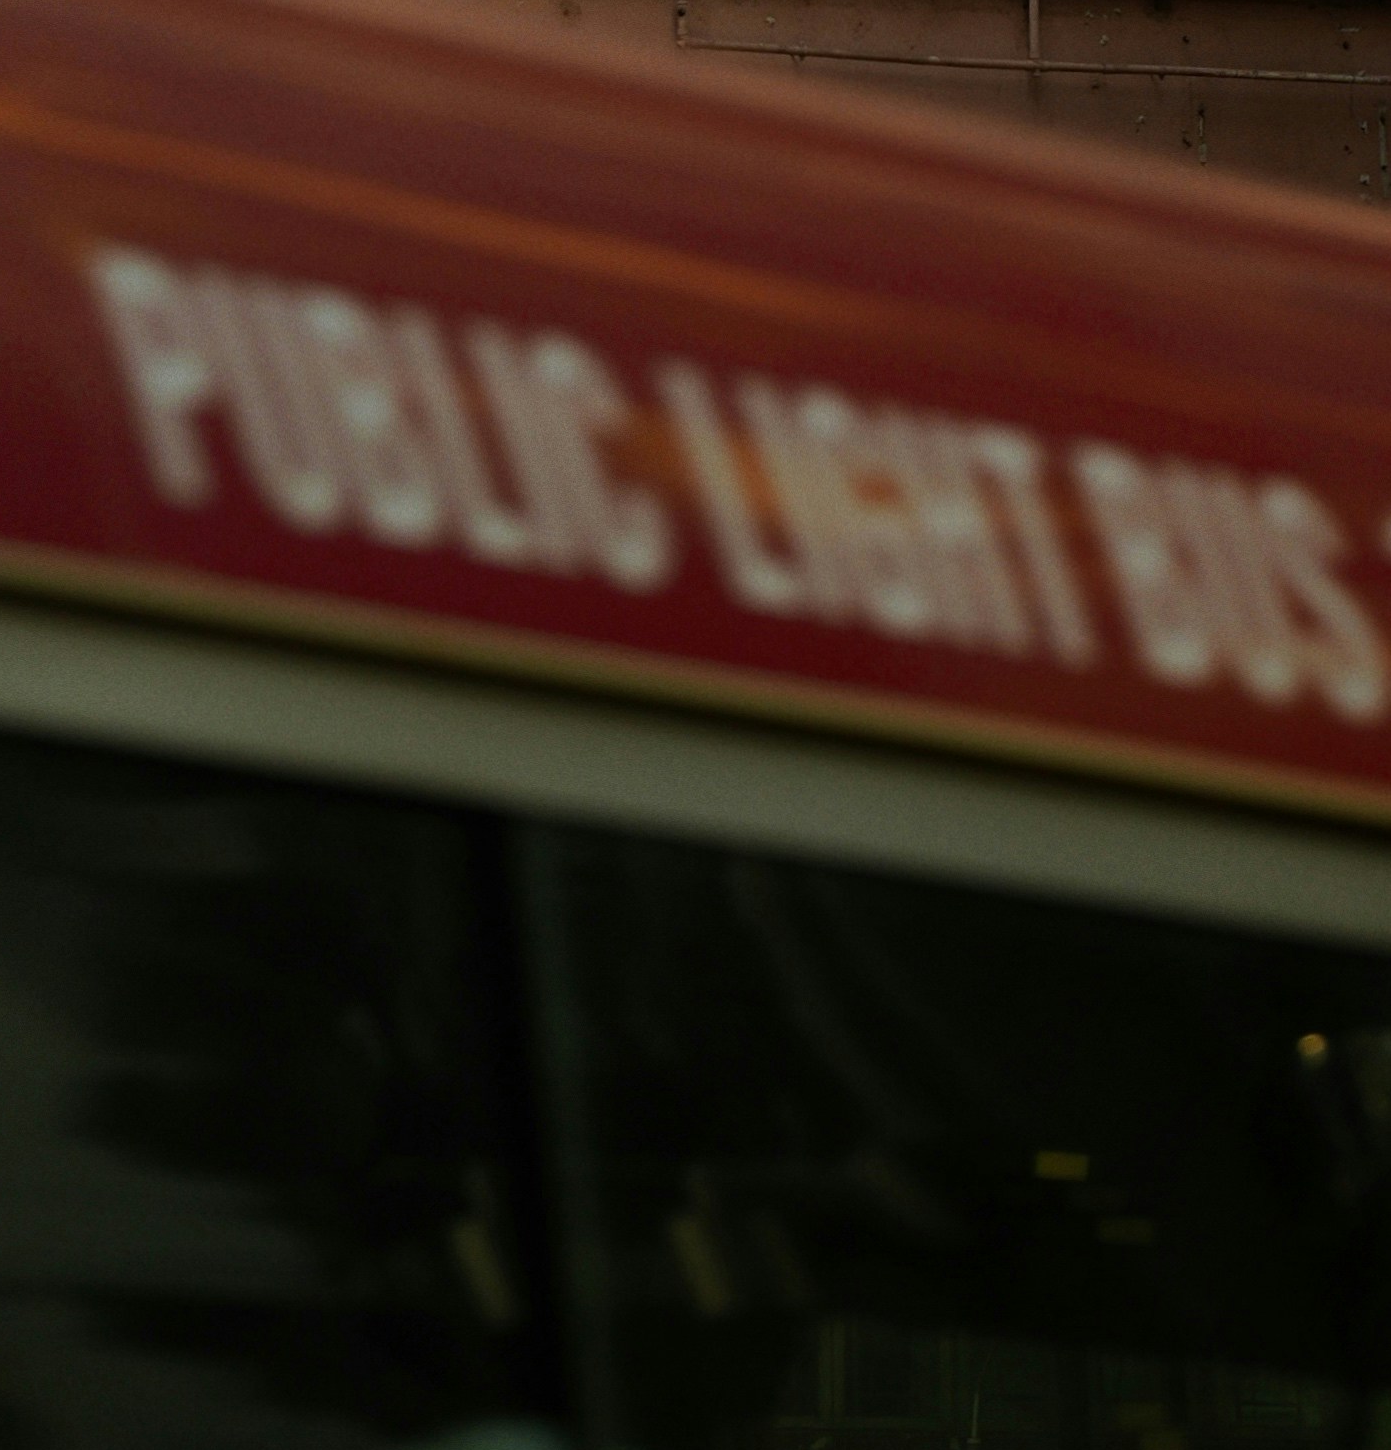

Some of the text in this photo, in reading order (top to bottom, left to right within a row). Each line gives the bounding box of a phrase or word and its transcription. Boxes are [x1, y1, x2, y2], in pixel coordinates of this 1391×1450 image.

[90, 242, 1389, 726] PUBLIC LIGHT BUS
